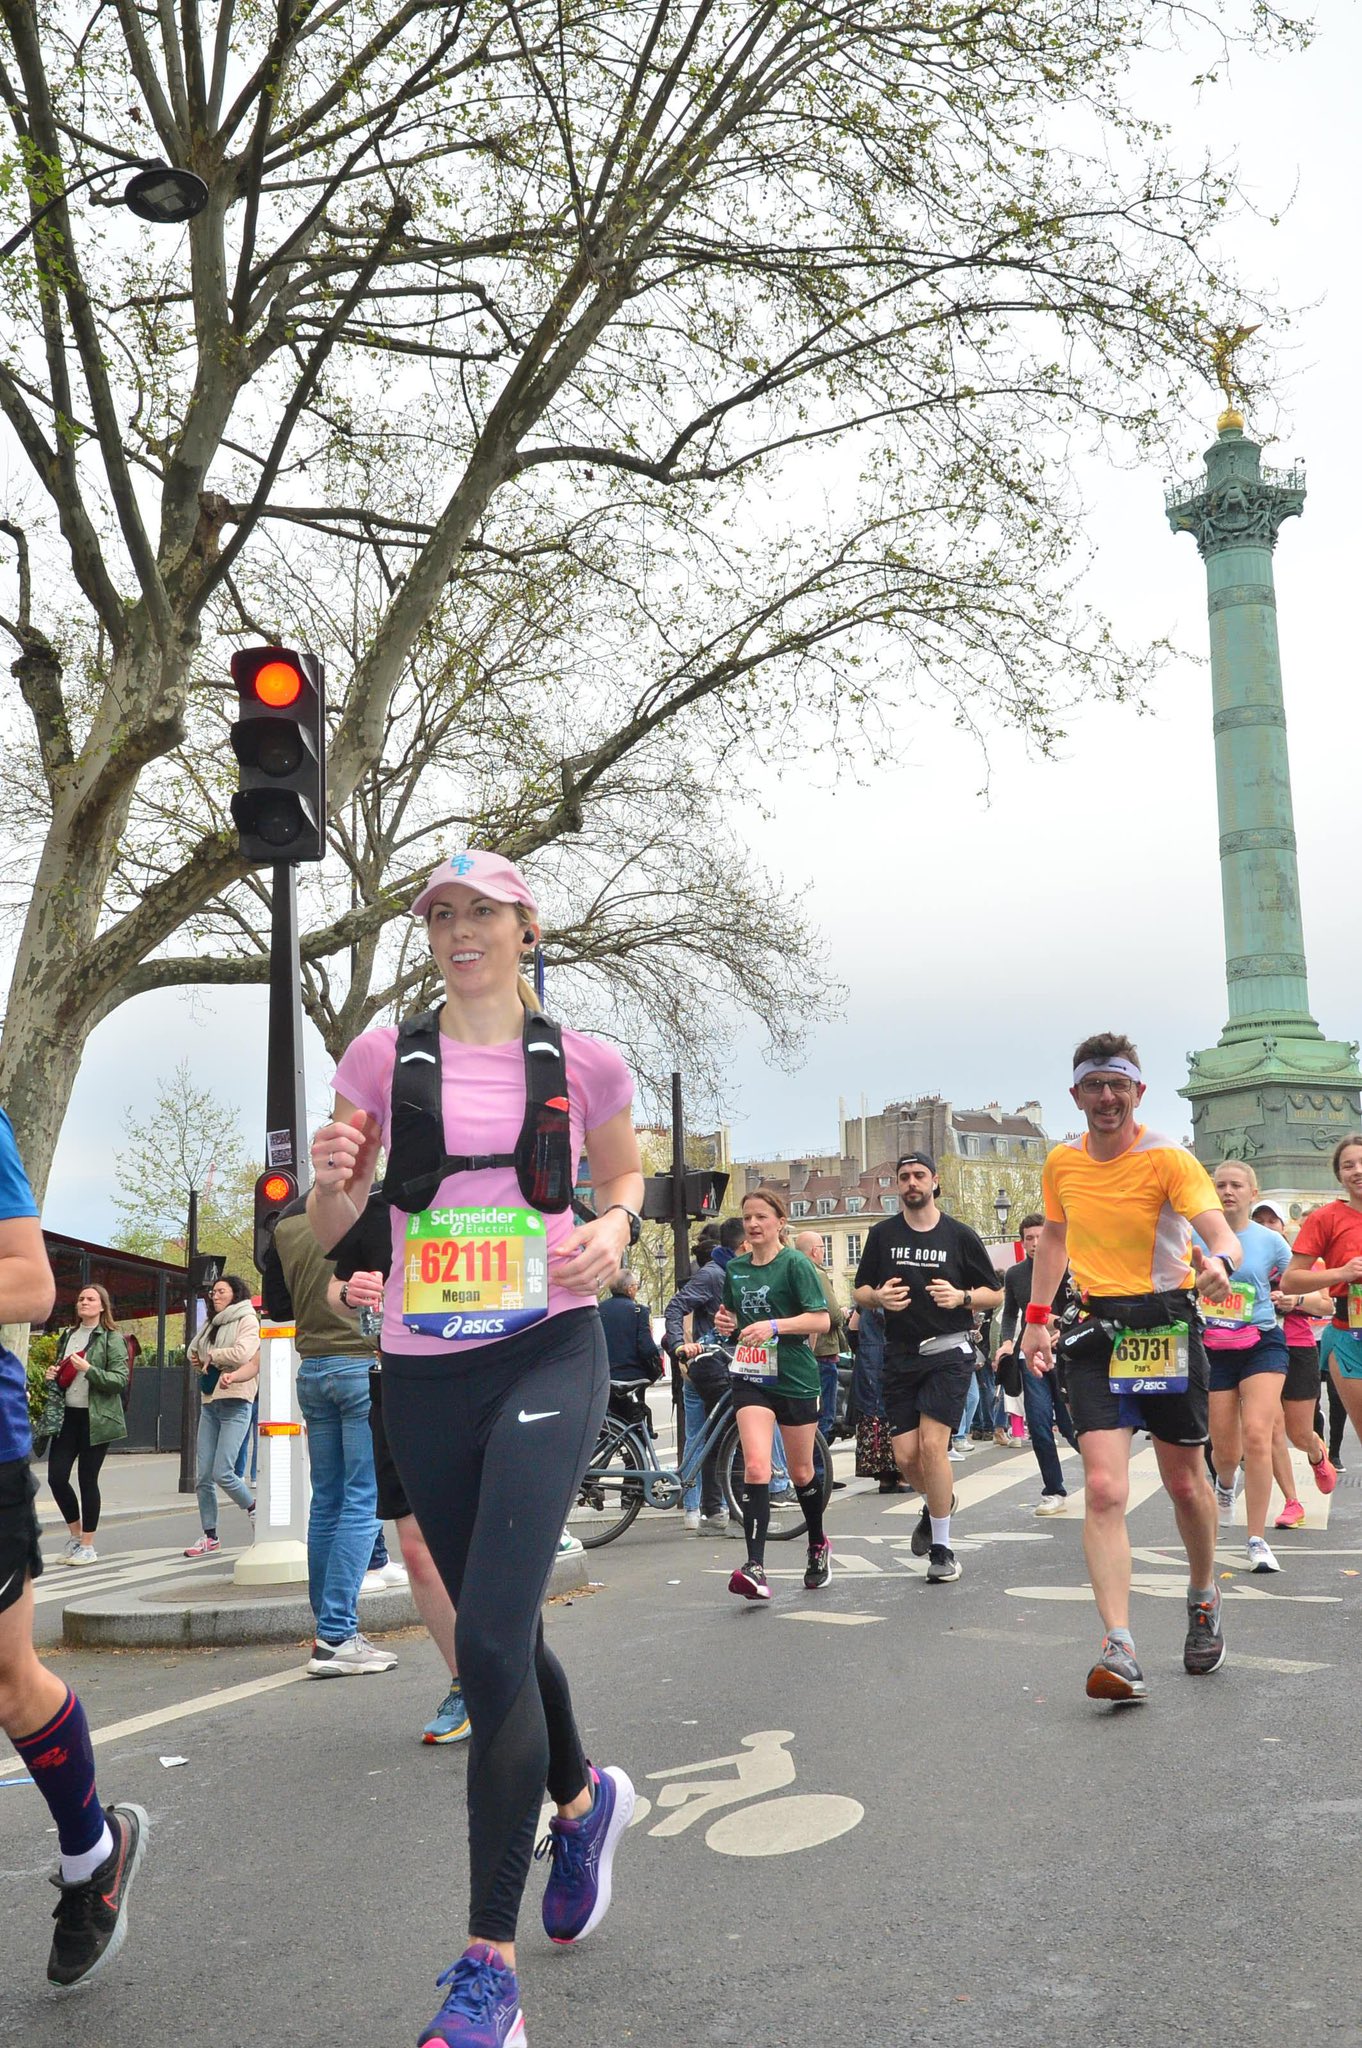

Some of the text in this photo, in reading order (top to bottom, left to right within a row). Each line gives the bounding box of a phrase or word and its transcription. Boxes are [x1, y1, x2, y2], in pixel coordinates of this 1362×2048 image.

[430, 1208, 517, 1226] Schneider
[466, 1223, 515, 1234] Electric
[421, 1240, 507, 1285] 62111
[891, 1247, 947, 1262] THE ROOM
[527, 1257, 544, 1276] 4h
[527, 1277, 542, 1293] 15
[442, 1289, 480, 1304] Megan
[1117, 1337, 1170, 1361] 63731
